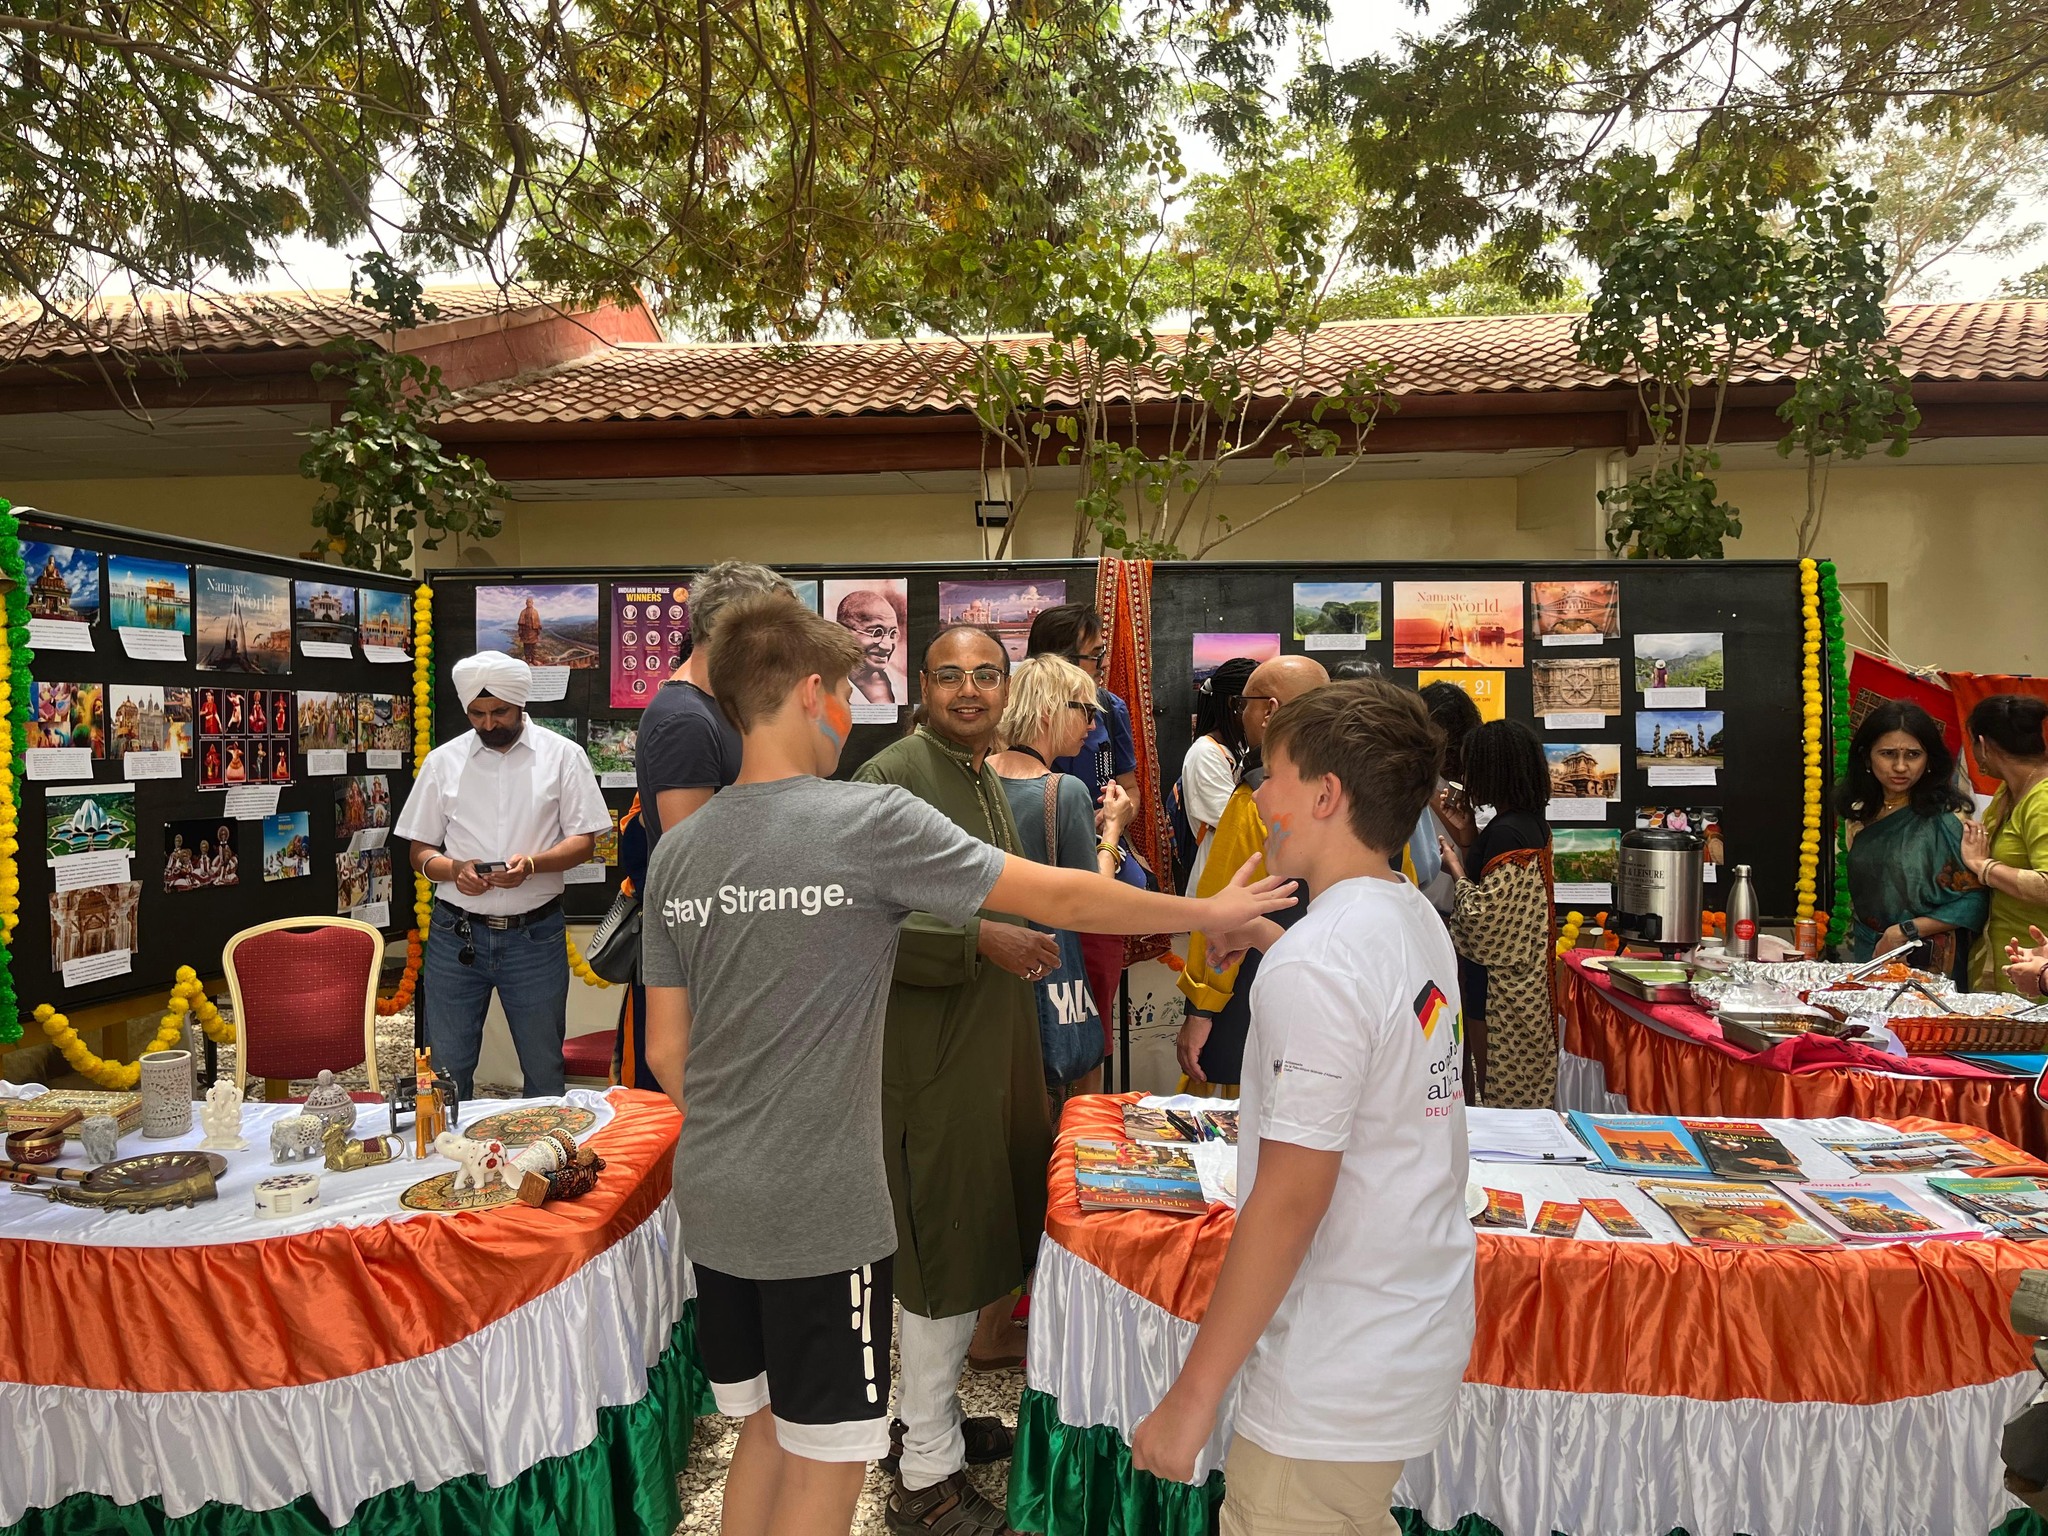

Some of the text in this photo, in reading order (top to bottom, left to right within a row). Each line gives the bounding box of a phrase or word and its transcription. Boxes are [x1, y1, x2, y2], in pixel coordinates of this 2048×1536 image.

[626, 593, 662, 602] WINNERS
[1475, 679, 1492, 695] 21
[718, 884, 854, 916] Strange.
[1668, 1187, 1734, 1198] Incredible
[1094, 1194, 1190, 1208] Incredible India
[1682, 1195, 1766, 1207] Rajasthan
